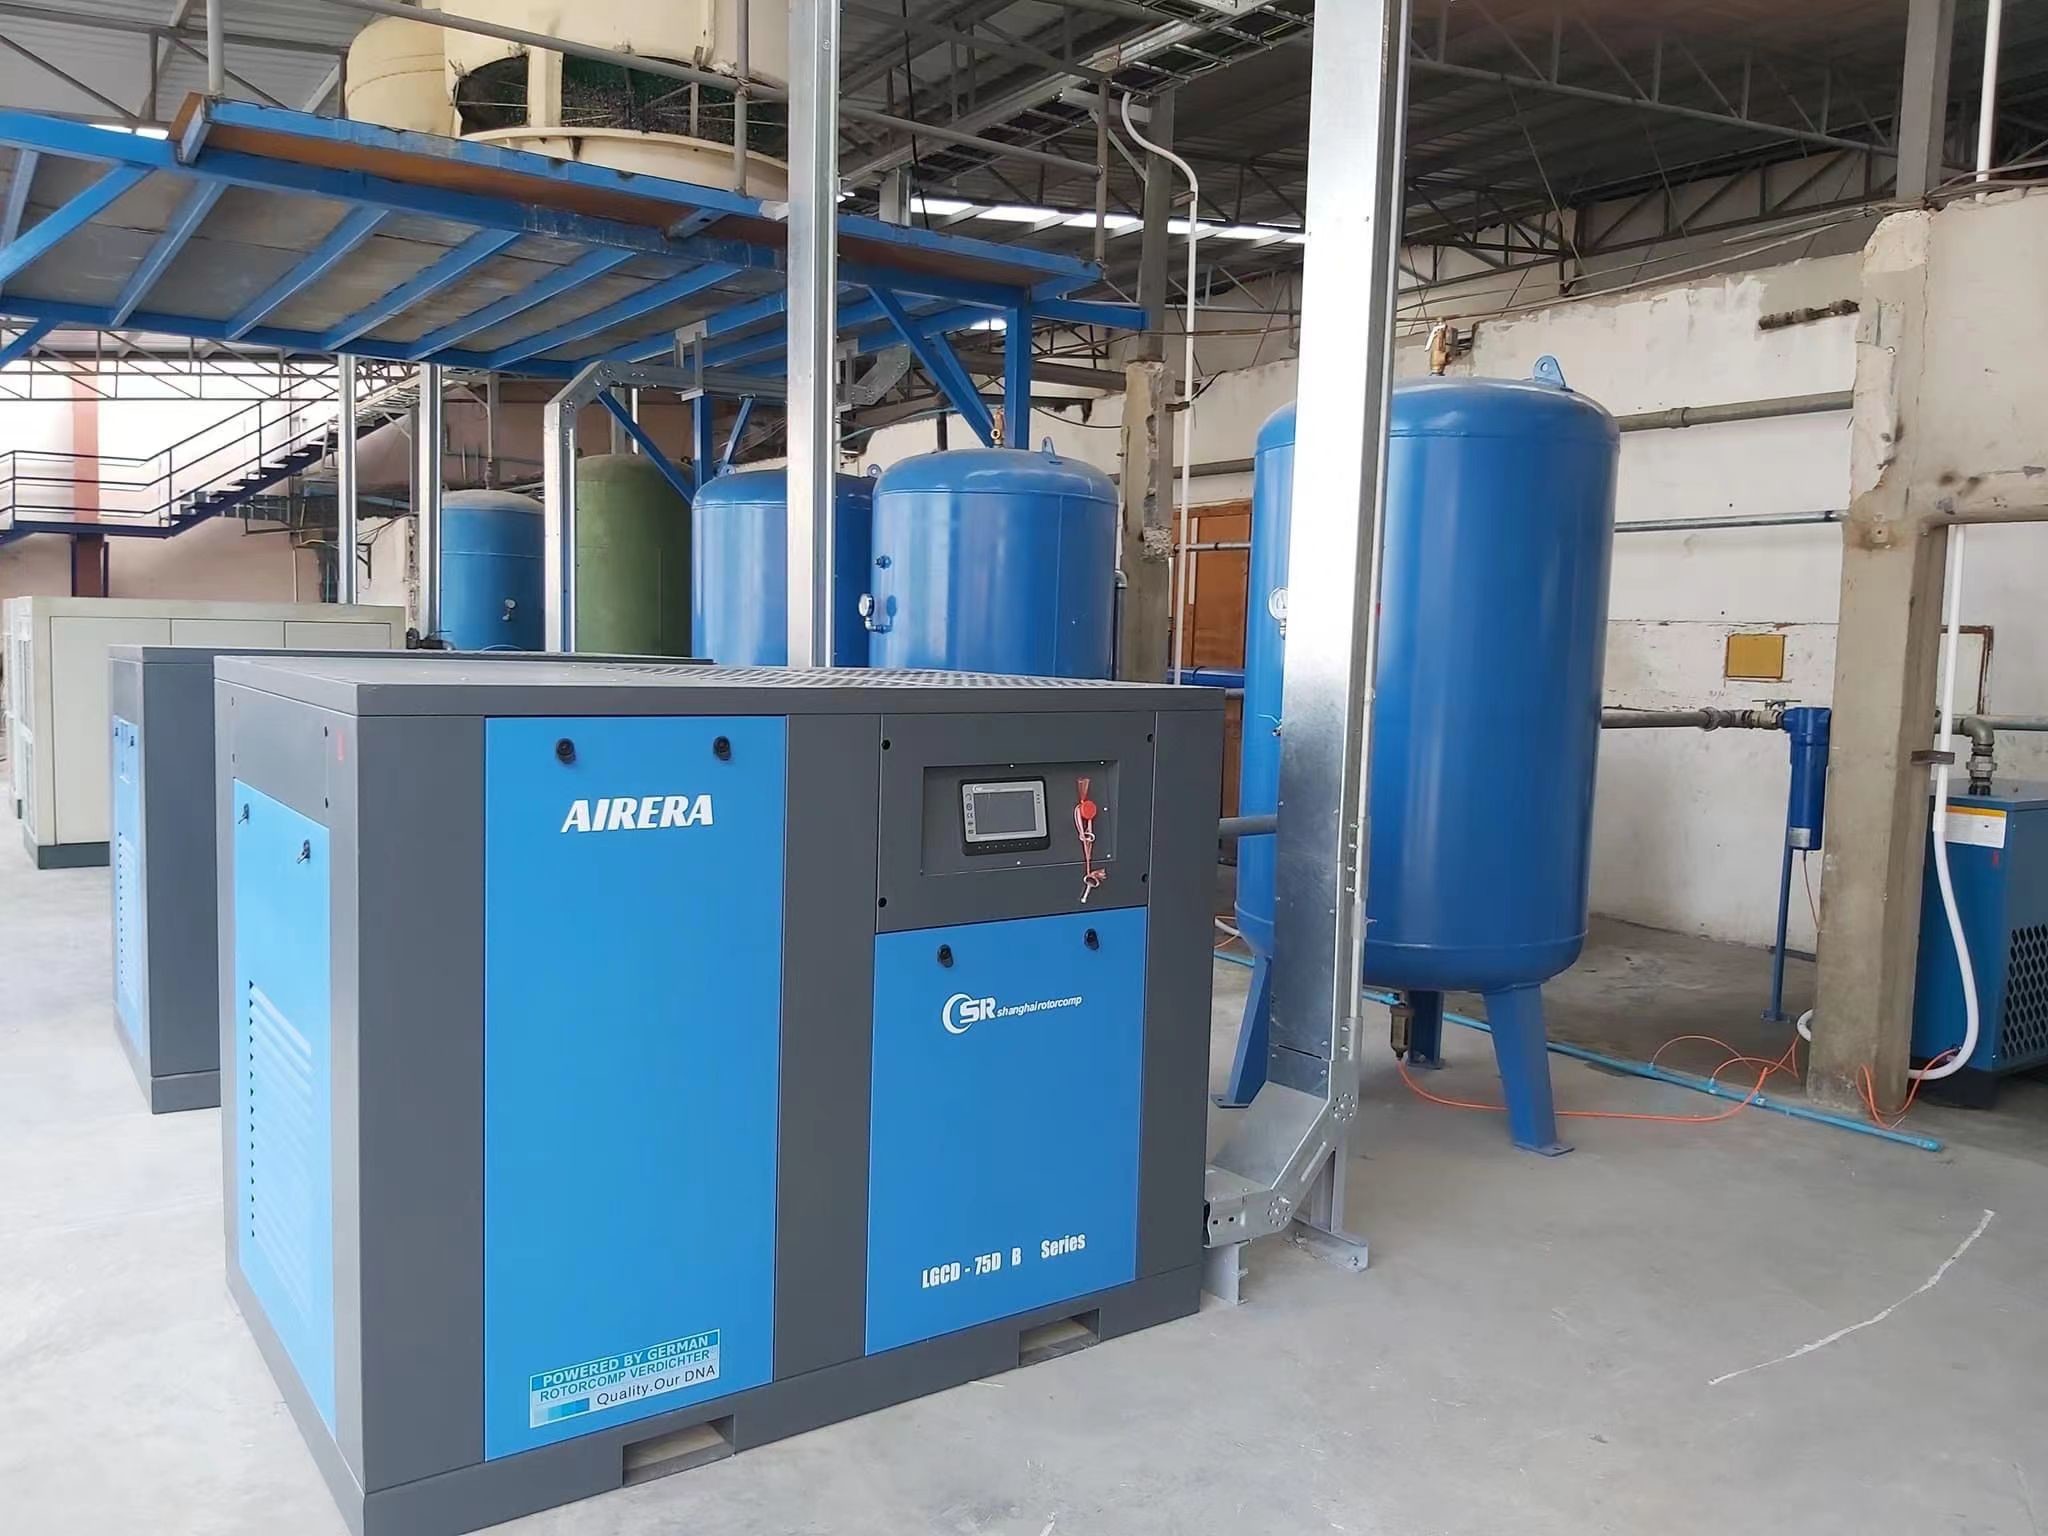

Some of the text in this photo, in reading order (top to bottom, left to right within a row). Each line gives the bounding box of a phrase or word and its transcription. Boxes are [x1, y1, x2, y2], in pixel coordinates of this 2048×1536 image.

[560, 795, 714, 833] AIRERA
[1011, 1247, 1022, 1266] B
[1040, 1234, 1086, 1259] Series
[540, 1350, 710, 1402] ROTORCOMP VERDICHTER
[543, 1335, 709, 1387] POWERED BY GERMAN
[684, 1364, 716, 1382] DNA
